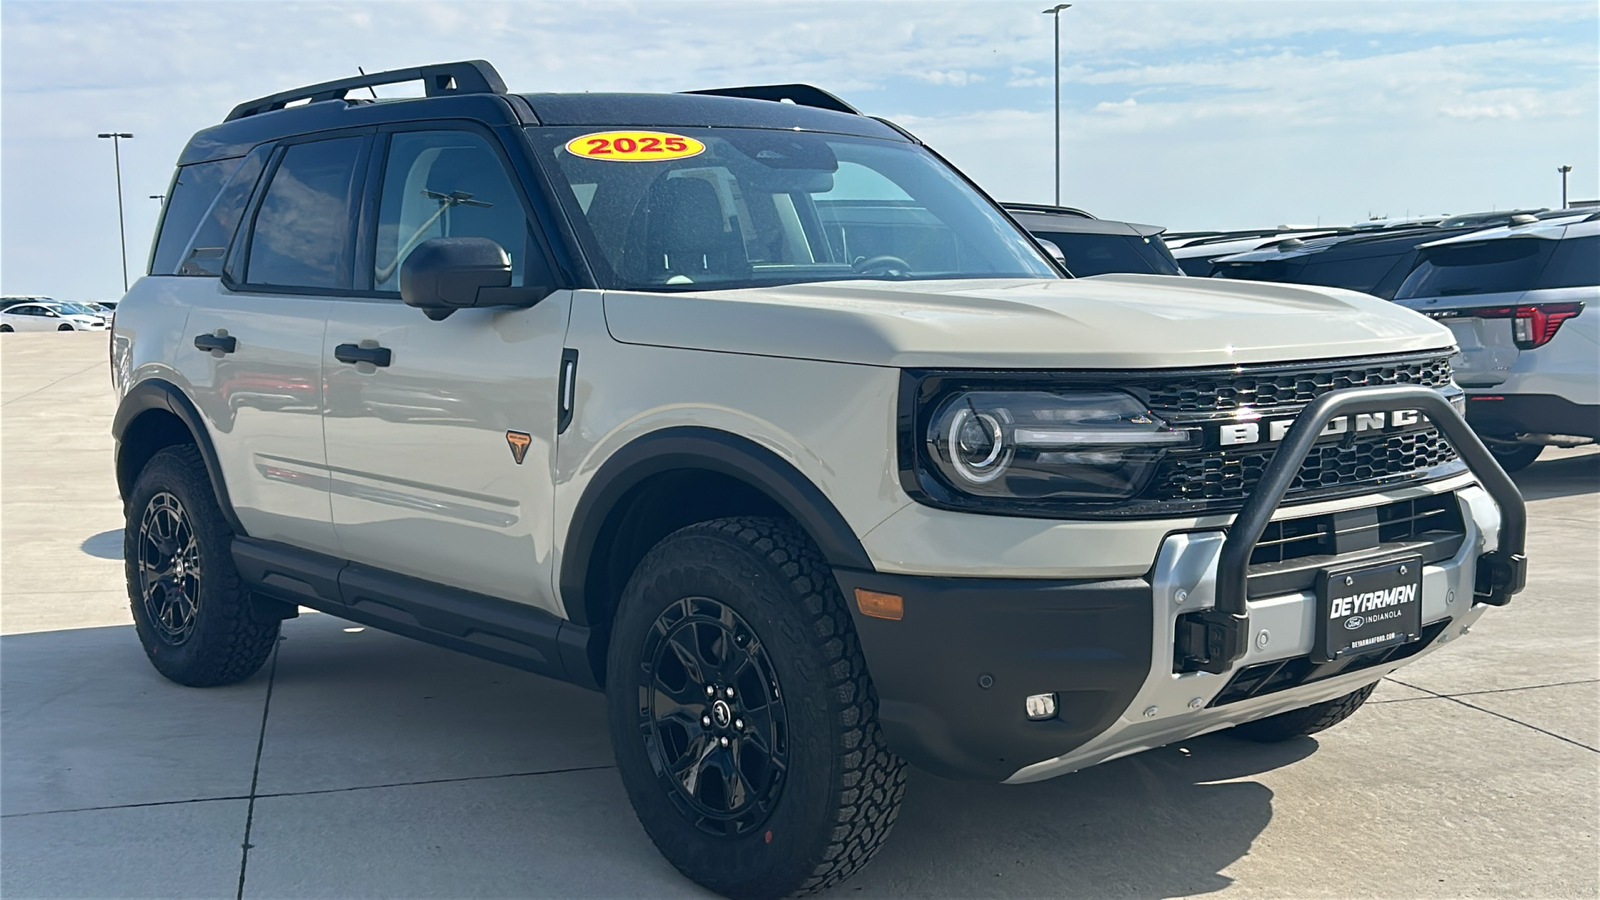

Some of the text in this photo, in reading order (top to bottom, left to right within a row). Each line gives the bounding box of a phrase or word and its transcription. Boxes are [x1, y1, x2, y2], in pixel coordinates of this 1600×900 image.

[586, 137, 688, 155] 2025
[1219, 409, 1430, 446] BRONC
[1330, 583, 1417, 619] DEYARMAN
[1346, 610, 1402, 628] Ford INDIANOLA
